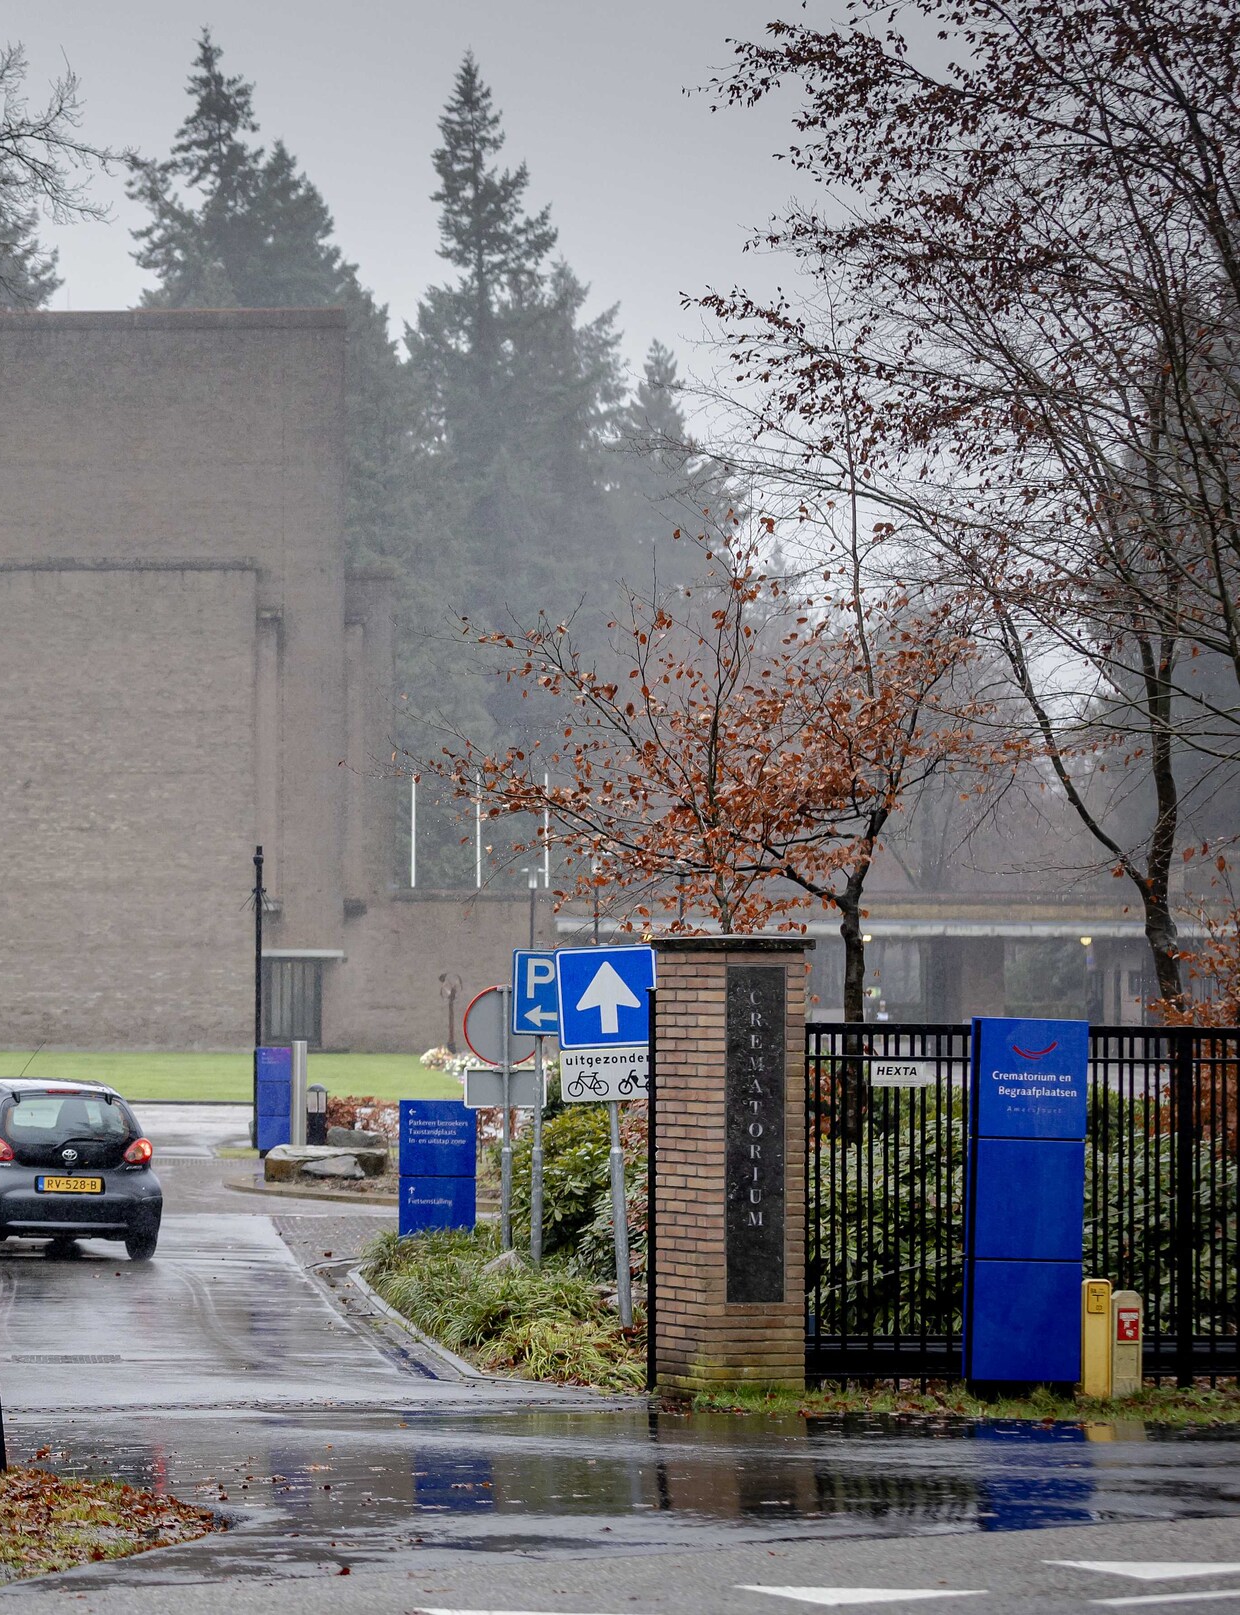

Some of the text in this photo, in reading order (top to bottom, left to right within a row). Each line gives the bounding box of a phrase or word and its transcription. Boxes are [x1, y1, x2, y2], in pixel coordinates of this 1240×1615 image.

[527, 958, 555, 998] P
[876, 1066, 918, 1076] HEXTA
[992, 1070, 1072, 1082] Crematorium en
[998, 1086, 1077, 1098] Begraafplaatsen
[747, 990, 764, 1226] CREMATORIUM
[47, 1179, 97, 1190] RV-528-B
